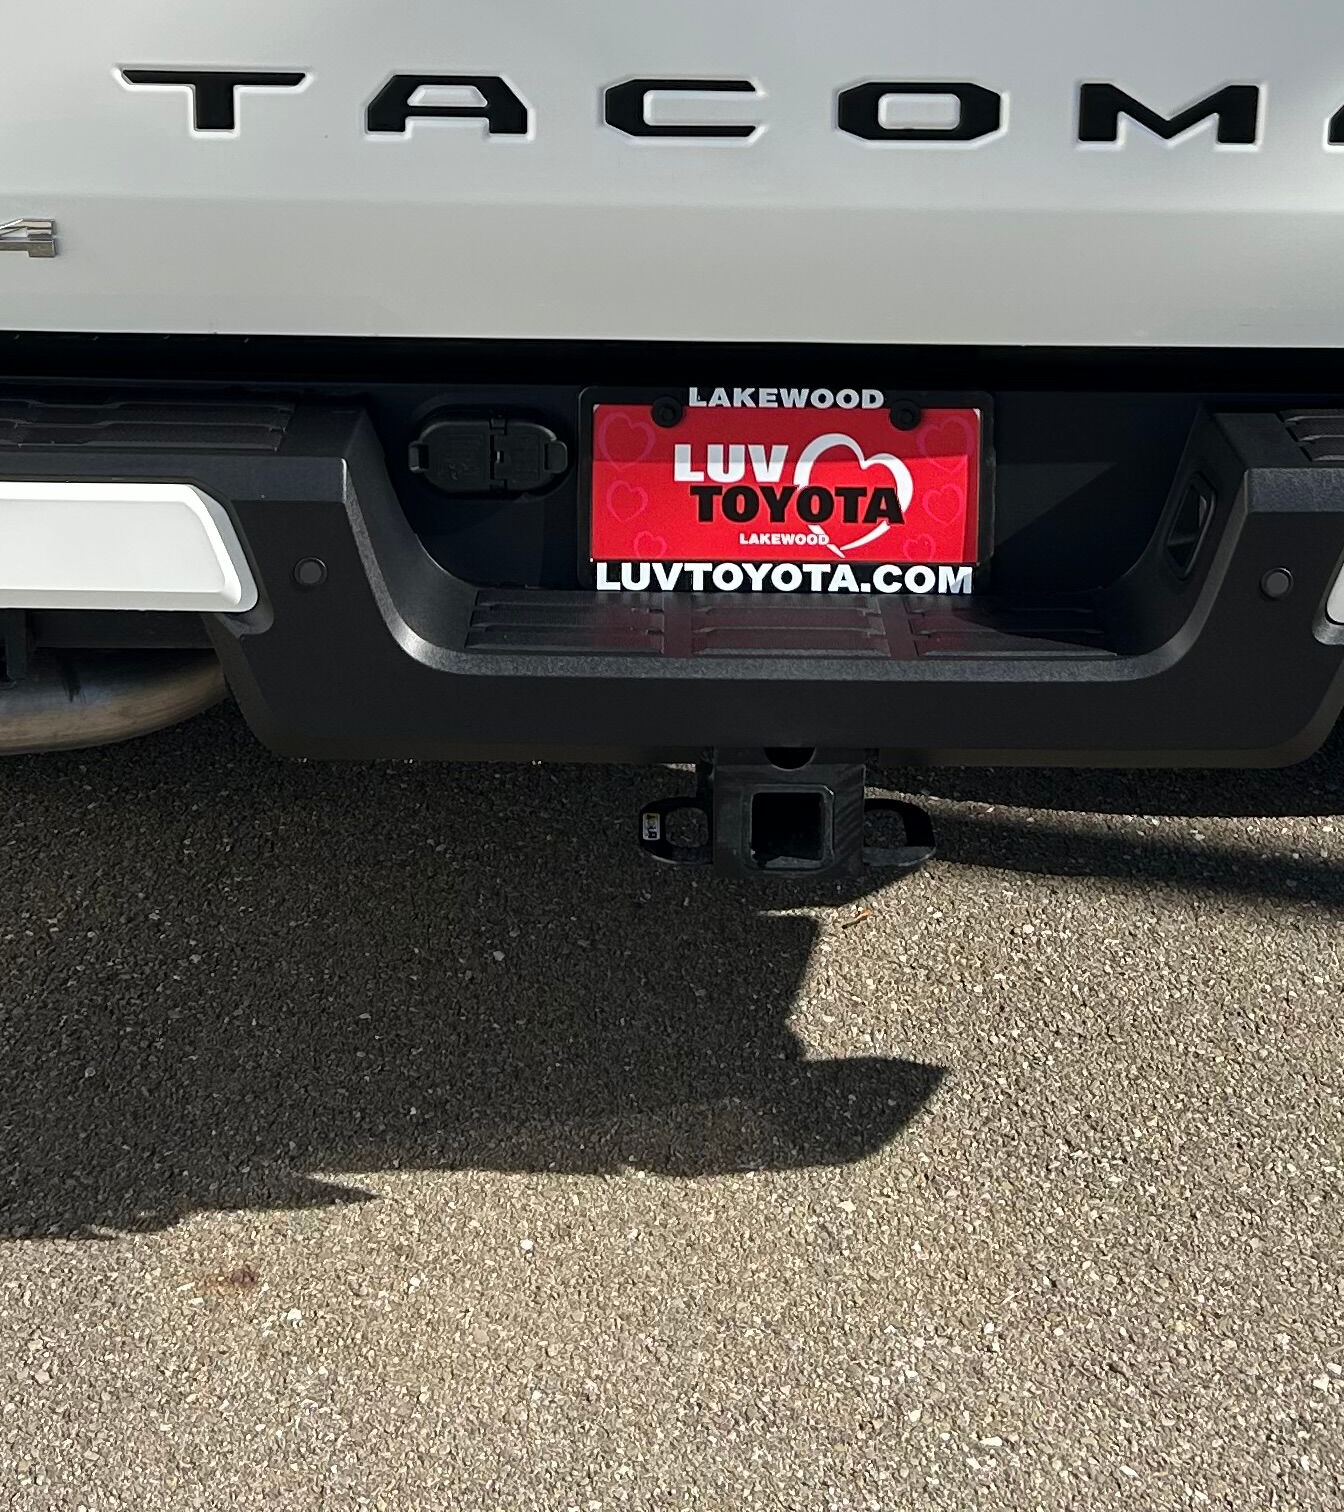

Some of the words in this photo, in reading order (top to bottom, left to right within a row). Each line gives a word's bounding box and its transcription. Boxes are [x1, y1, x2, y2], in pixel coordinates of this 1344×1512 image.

[688, 386, 884, 409] LAKEWOOD
[674, 444, 789, 483] LUV
[689, 485, 905, 524] TOYOTA
[739, 532, 830, 546] LAKEWOOD
[596, 562, 973, 594] LUVTOYOTA.COM
